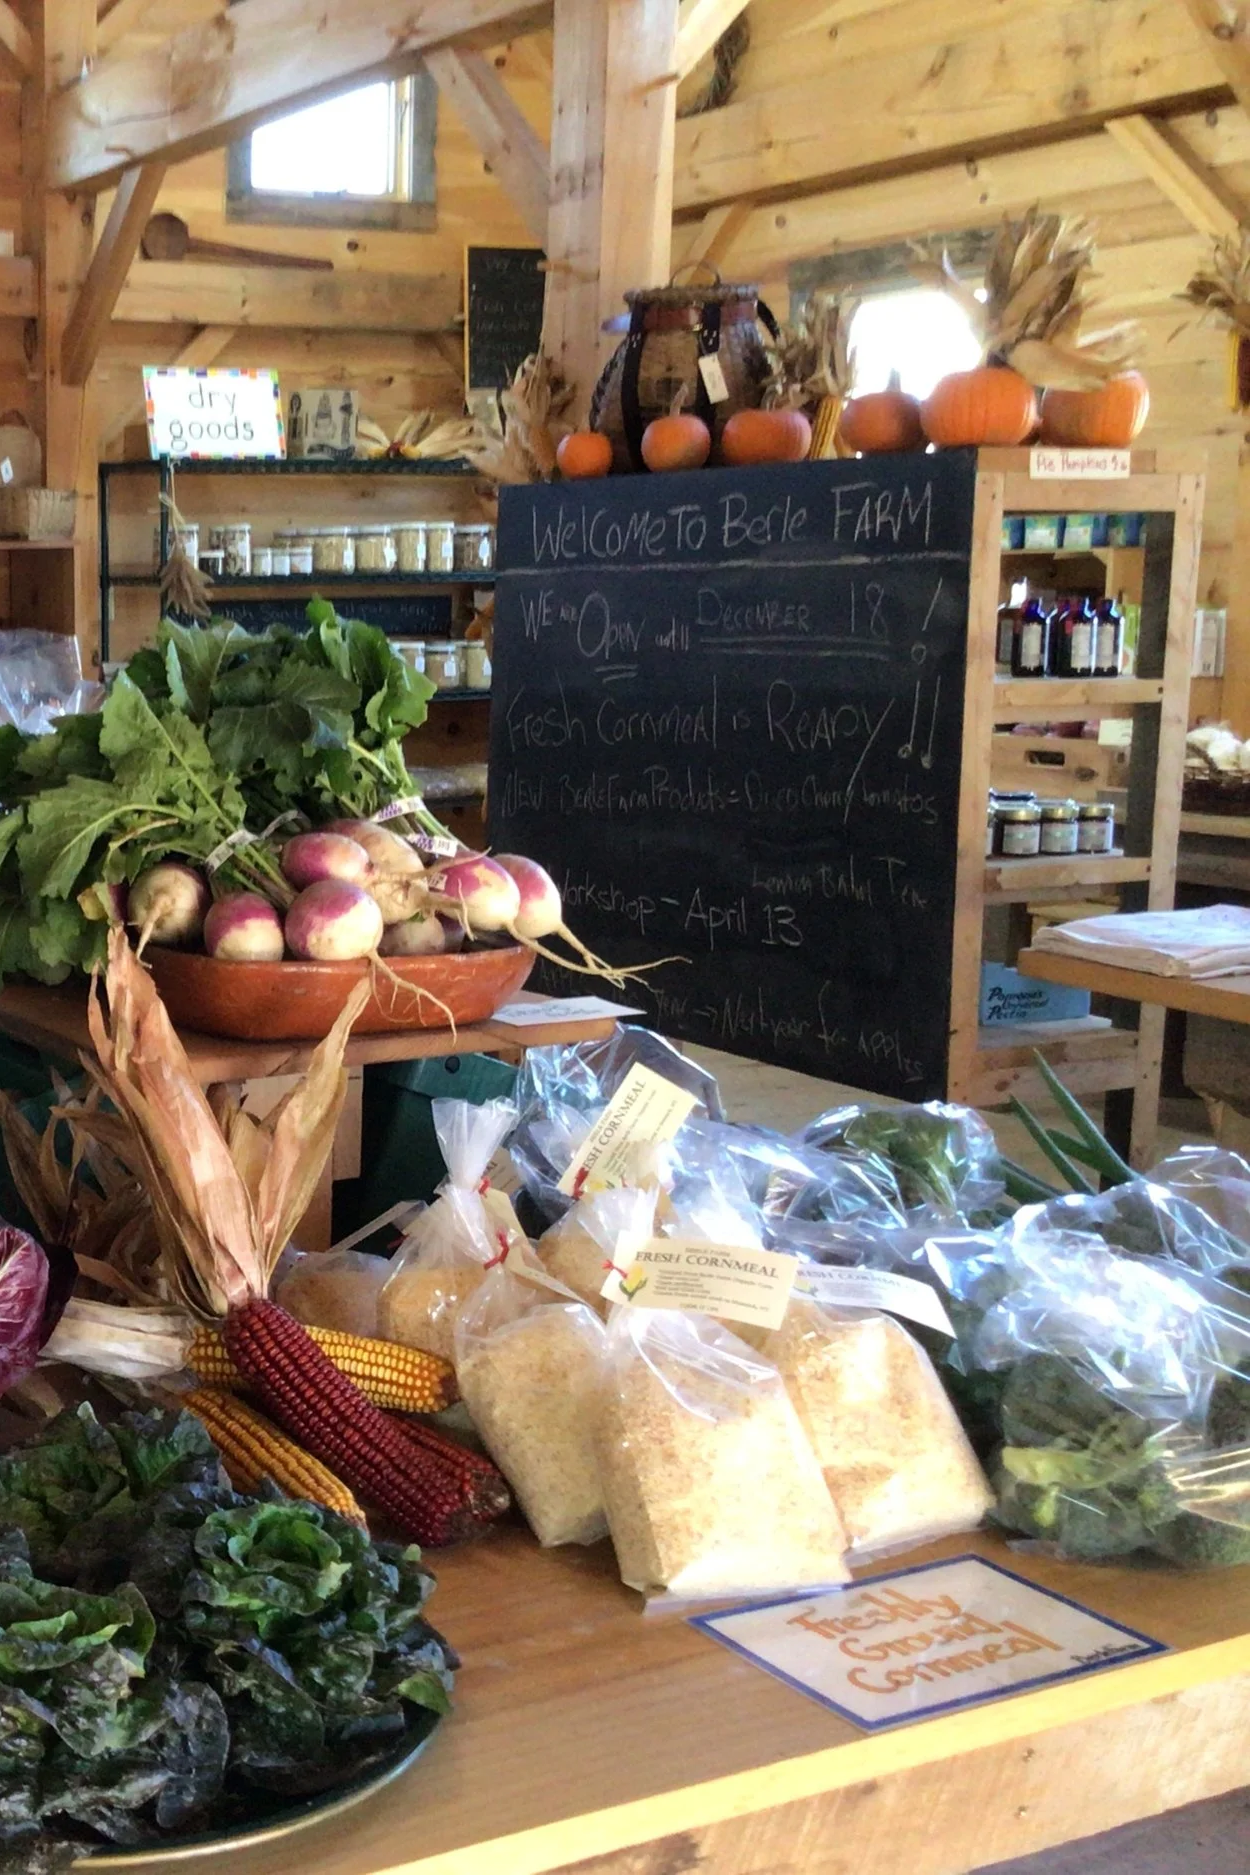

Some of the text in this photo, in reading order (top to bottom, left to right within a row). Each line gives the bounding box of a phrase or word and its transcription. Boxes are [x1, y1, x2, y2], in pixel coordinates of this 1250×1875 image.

[189, 383, 236, 416] dry
[169, 416, 254, 451] goods
[719, 492, 807, 548] Berle
[850, 581, 888, 638] 18
[506, 666, 587, 752] Fresh
[685, 887, 747, 952] April
[761, 904, 804, 947] 13
[598, 1080, 646, 1147] CORNMEAL
[635, 1251, 779, 1279] FRESH CORNMEAL
[797, 1269, 836, 1281] RESH
[786, 1587, 961, 1639] Freshly
[839, 1612, 1004, 1662] Ground
[847, 1620, 1064, 1694] Cornmeal
